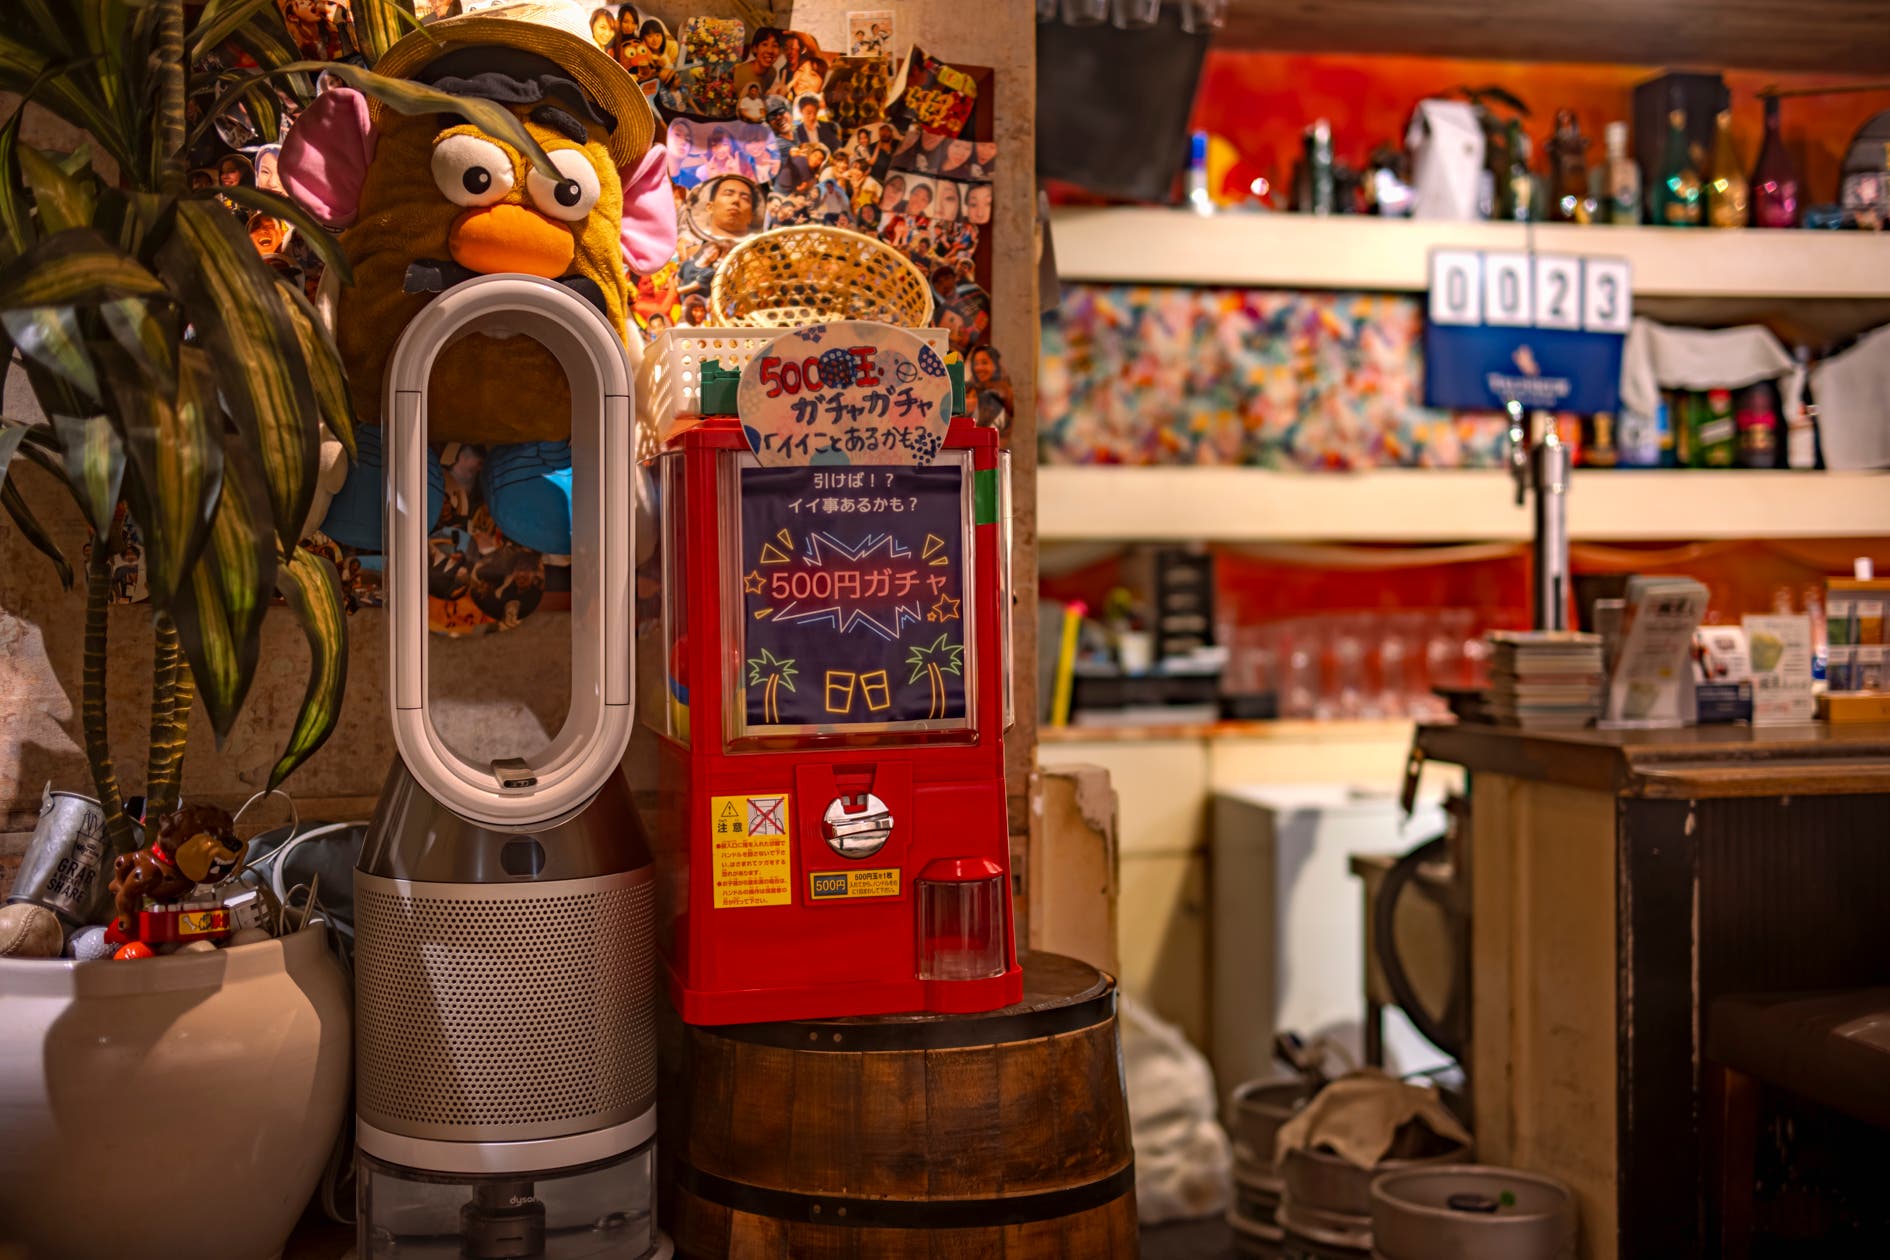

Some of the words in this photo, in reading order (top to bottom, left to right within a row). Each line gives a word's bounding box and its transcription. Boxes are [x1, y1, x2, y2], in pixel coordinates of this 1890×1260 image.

[1447, 266, 1618, 319] 0023
[791, 385, 933, 425] ガチャガチャ
[788, 497, 918, 514] イイ事あるかも?
[771, 568, 947, 600] 500円ガチャ
[717, 822, 742, 833] 注意
[816, 880, 846, 892] 500円
